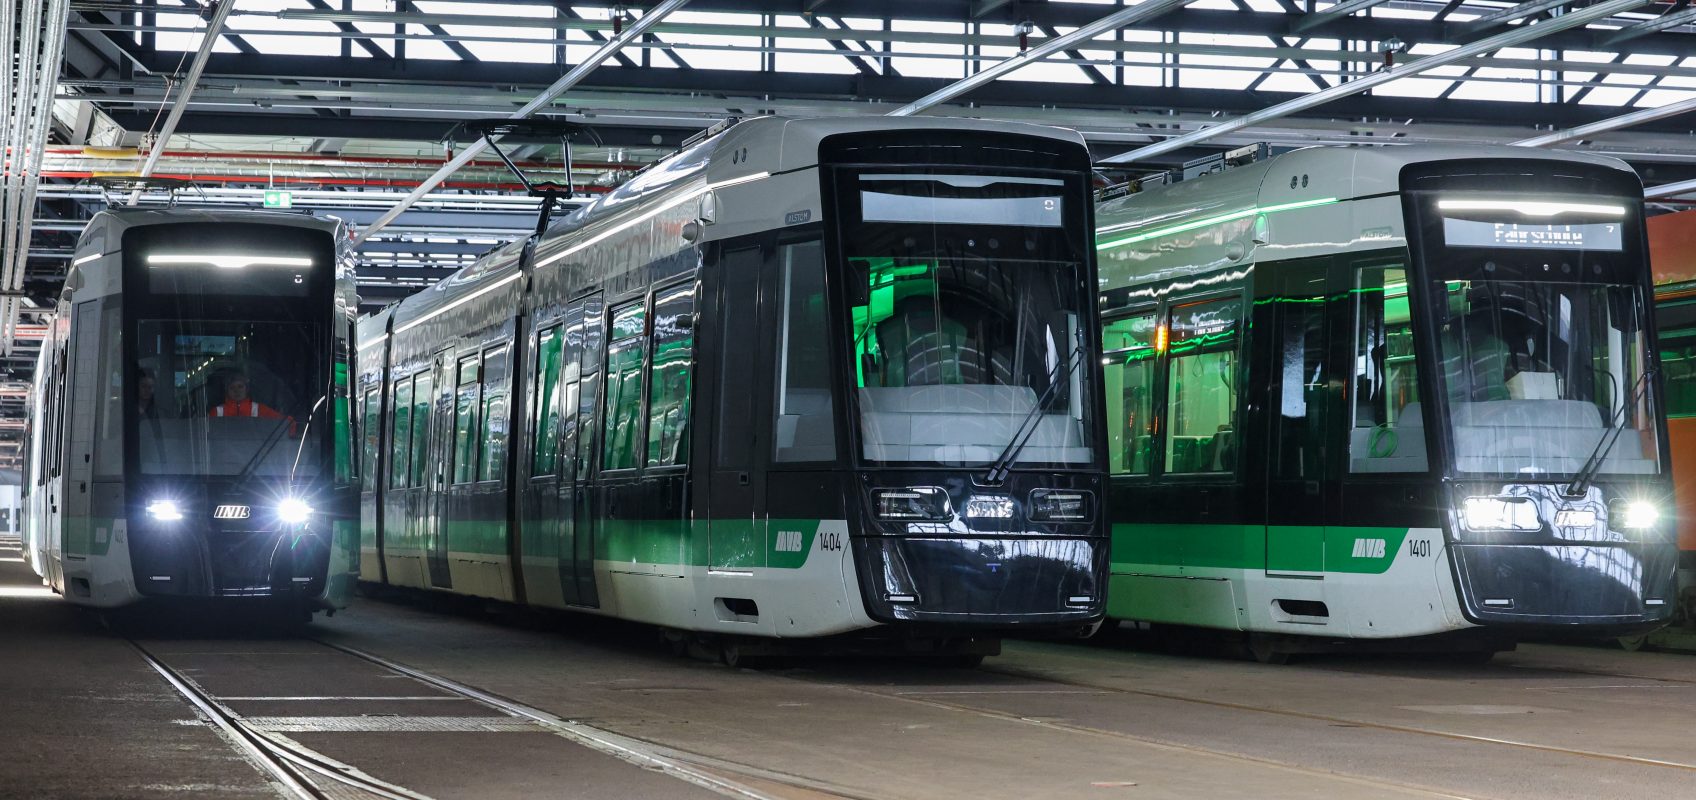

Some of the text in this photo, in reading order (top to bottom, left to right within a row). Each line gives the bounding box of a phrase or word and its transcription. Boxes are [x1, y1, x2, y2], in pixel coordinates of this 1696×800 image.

[775, 531, 803, 552] MVB
[819, 532, 842, 552] 1404
[1351, 538, 1386, 558] MVB
[1408, 539, 1431, 558] 1401
